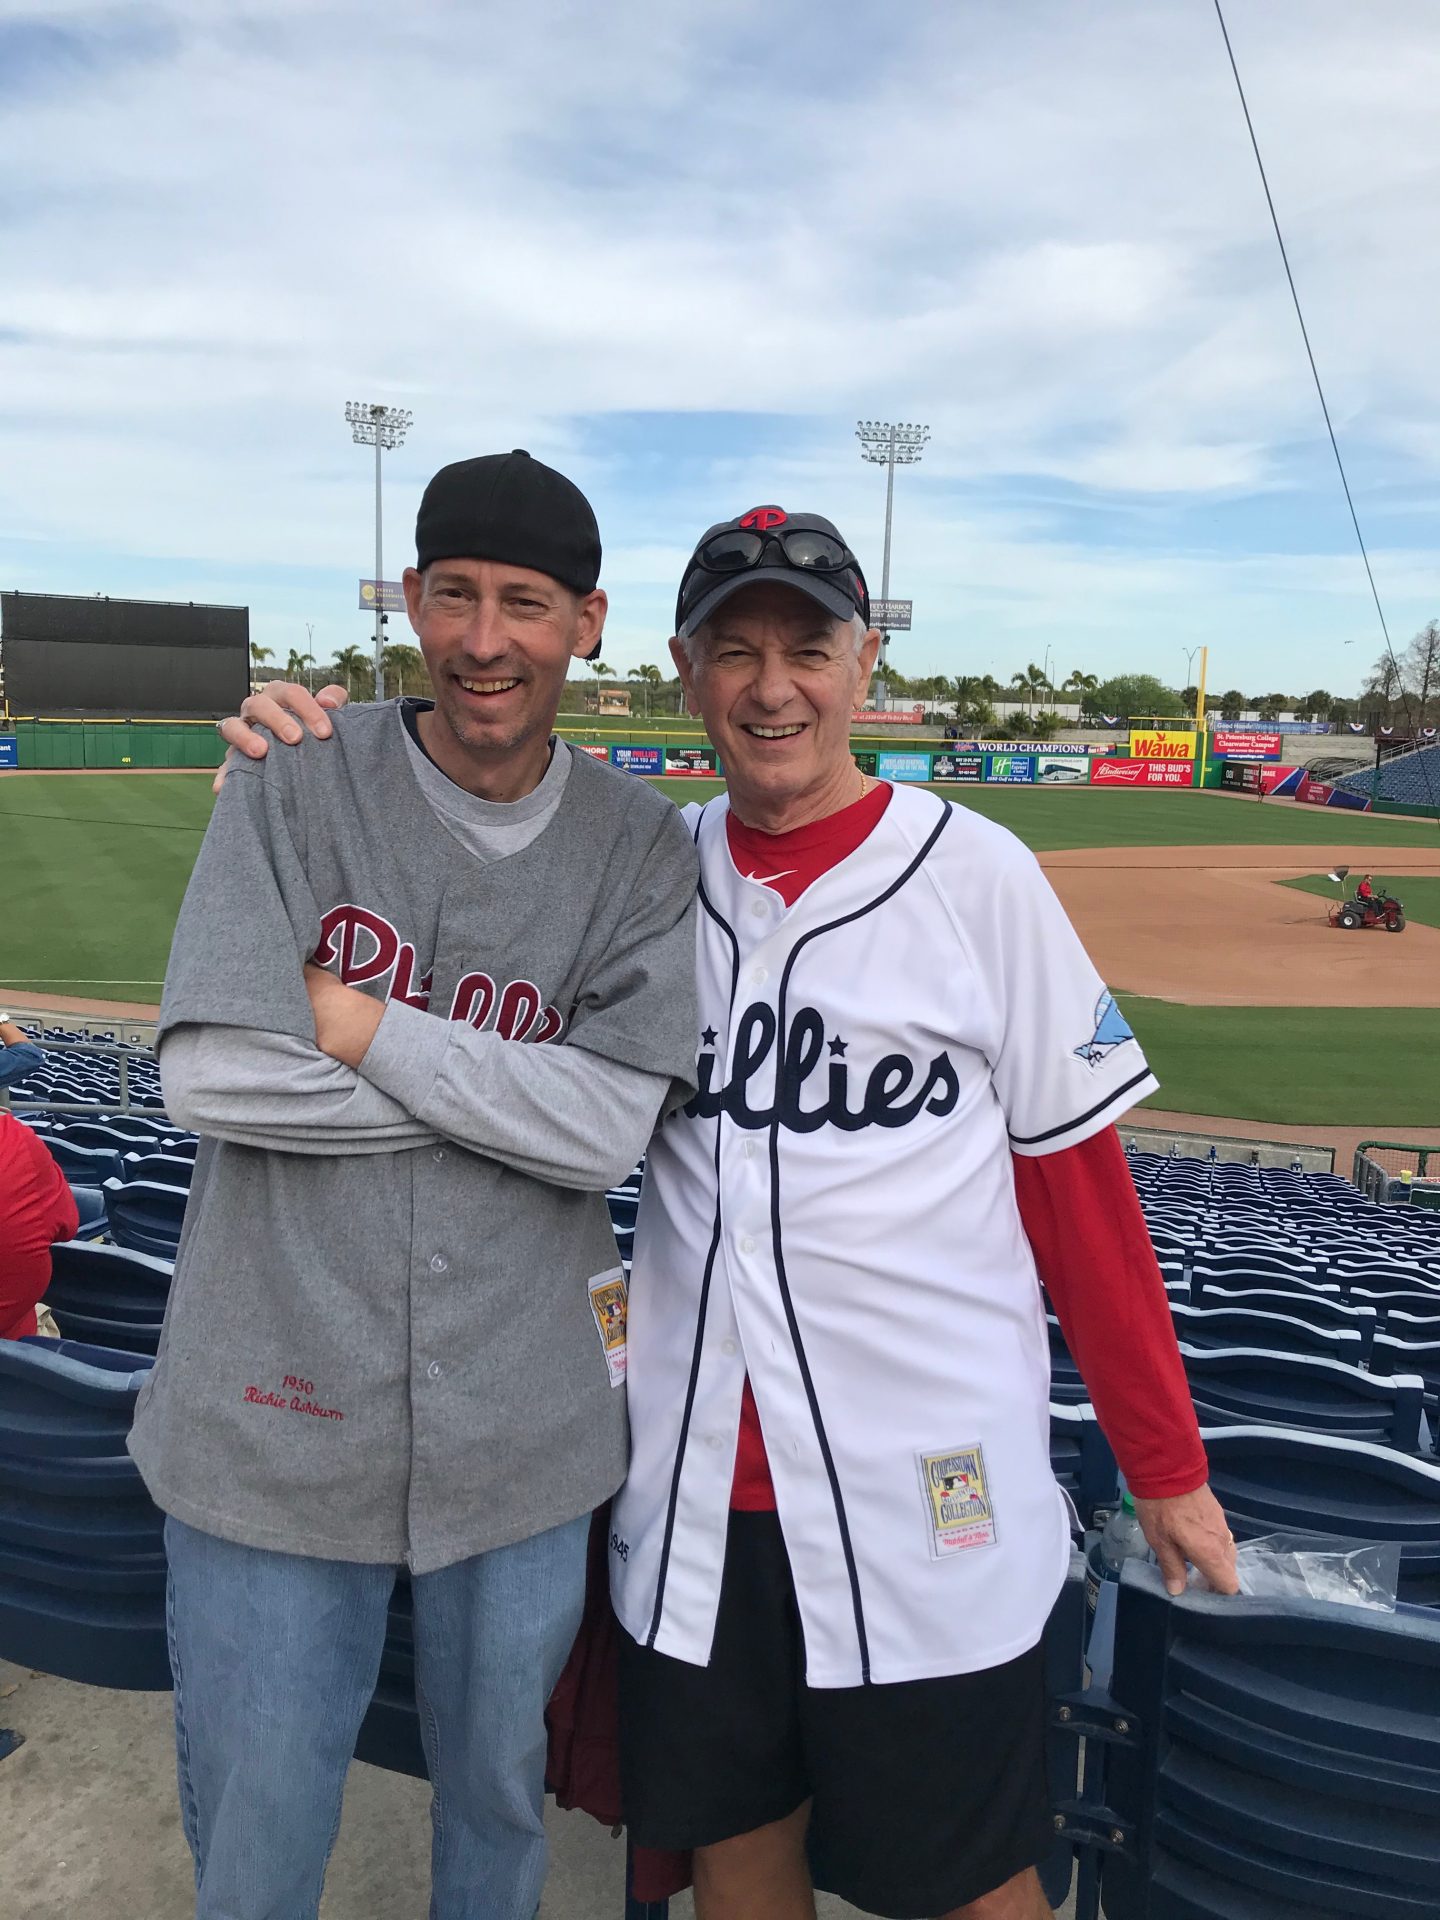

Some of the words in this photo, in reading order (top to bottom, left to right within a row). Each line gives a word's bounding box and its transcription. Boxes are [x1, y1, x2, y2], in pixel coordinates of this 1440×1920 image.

[739, 508, 787, 530] P
[1225, 734, 1256, 742] Petersburg
[632, 750, 658, 758] PHILLIES
[977, 743, 1017, 752] WORLD
[1019, 743, 1085, 753] CHAMPIONS
[1135, 739, 1189, 757] Wawa
[1100, 766, 1139, 775] Budweiser
[1148, 763, 1166, 772] THIS
[1168, 764, 1191, 773] BUD'S
[1148, 773, 1163, 781] FOR
[1164, 773, 1182, 782] YOU.
[684, 1001, 960, 1133] illies
[282, 1375, 314, 1395] 1950
[243, 1386, 287, 1408] Richie
[290, 1397, 345, 1420] Ashburn
[940, 1496, 987, 1524] COLLECTION
